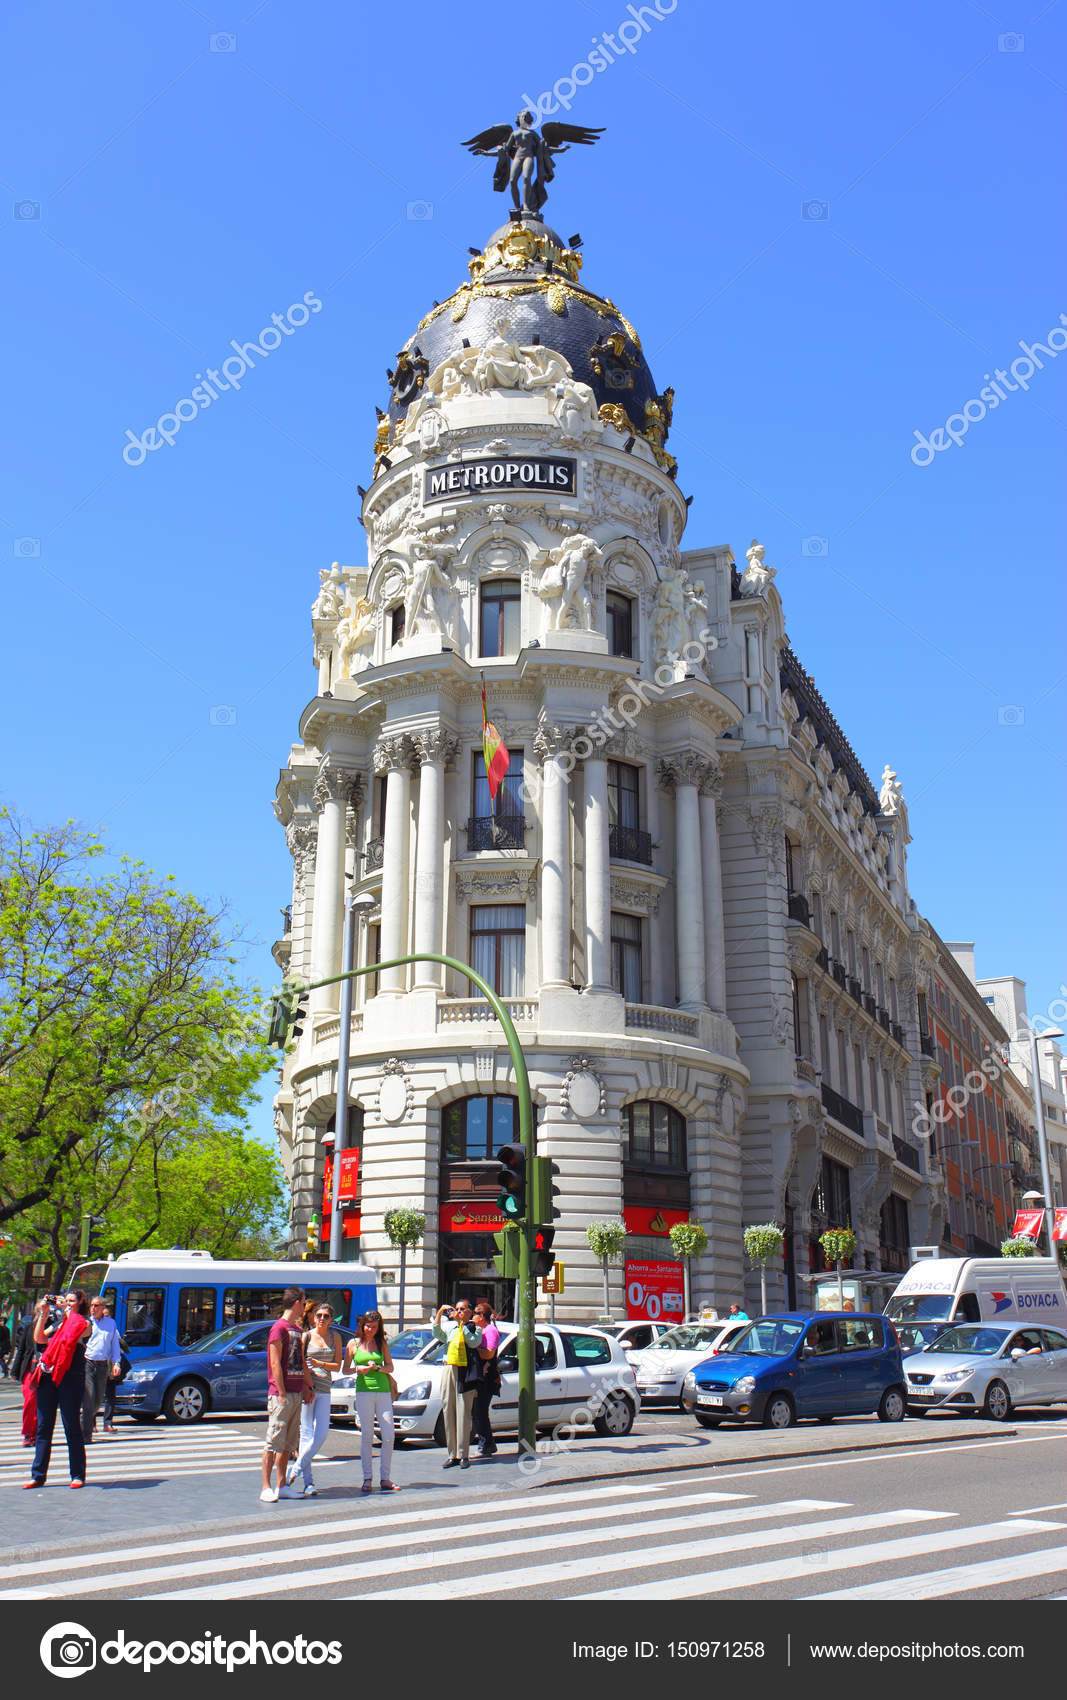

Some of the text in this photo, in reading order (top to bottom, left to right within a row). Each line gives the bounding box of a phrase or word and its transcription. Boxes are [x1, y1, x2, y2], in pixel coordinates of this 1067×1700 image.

[431, 464, 569, 494] METROPOLIS
[468, 1212, 506, 1222] Santan
[628, 1264, 649, 1272] Ahorra
[1017, 1293, 1060, 1308] BOYACA
